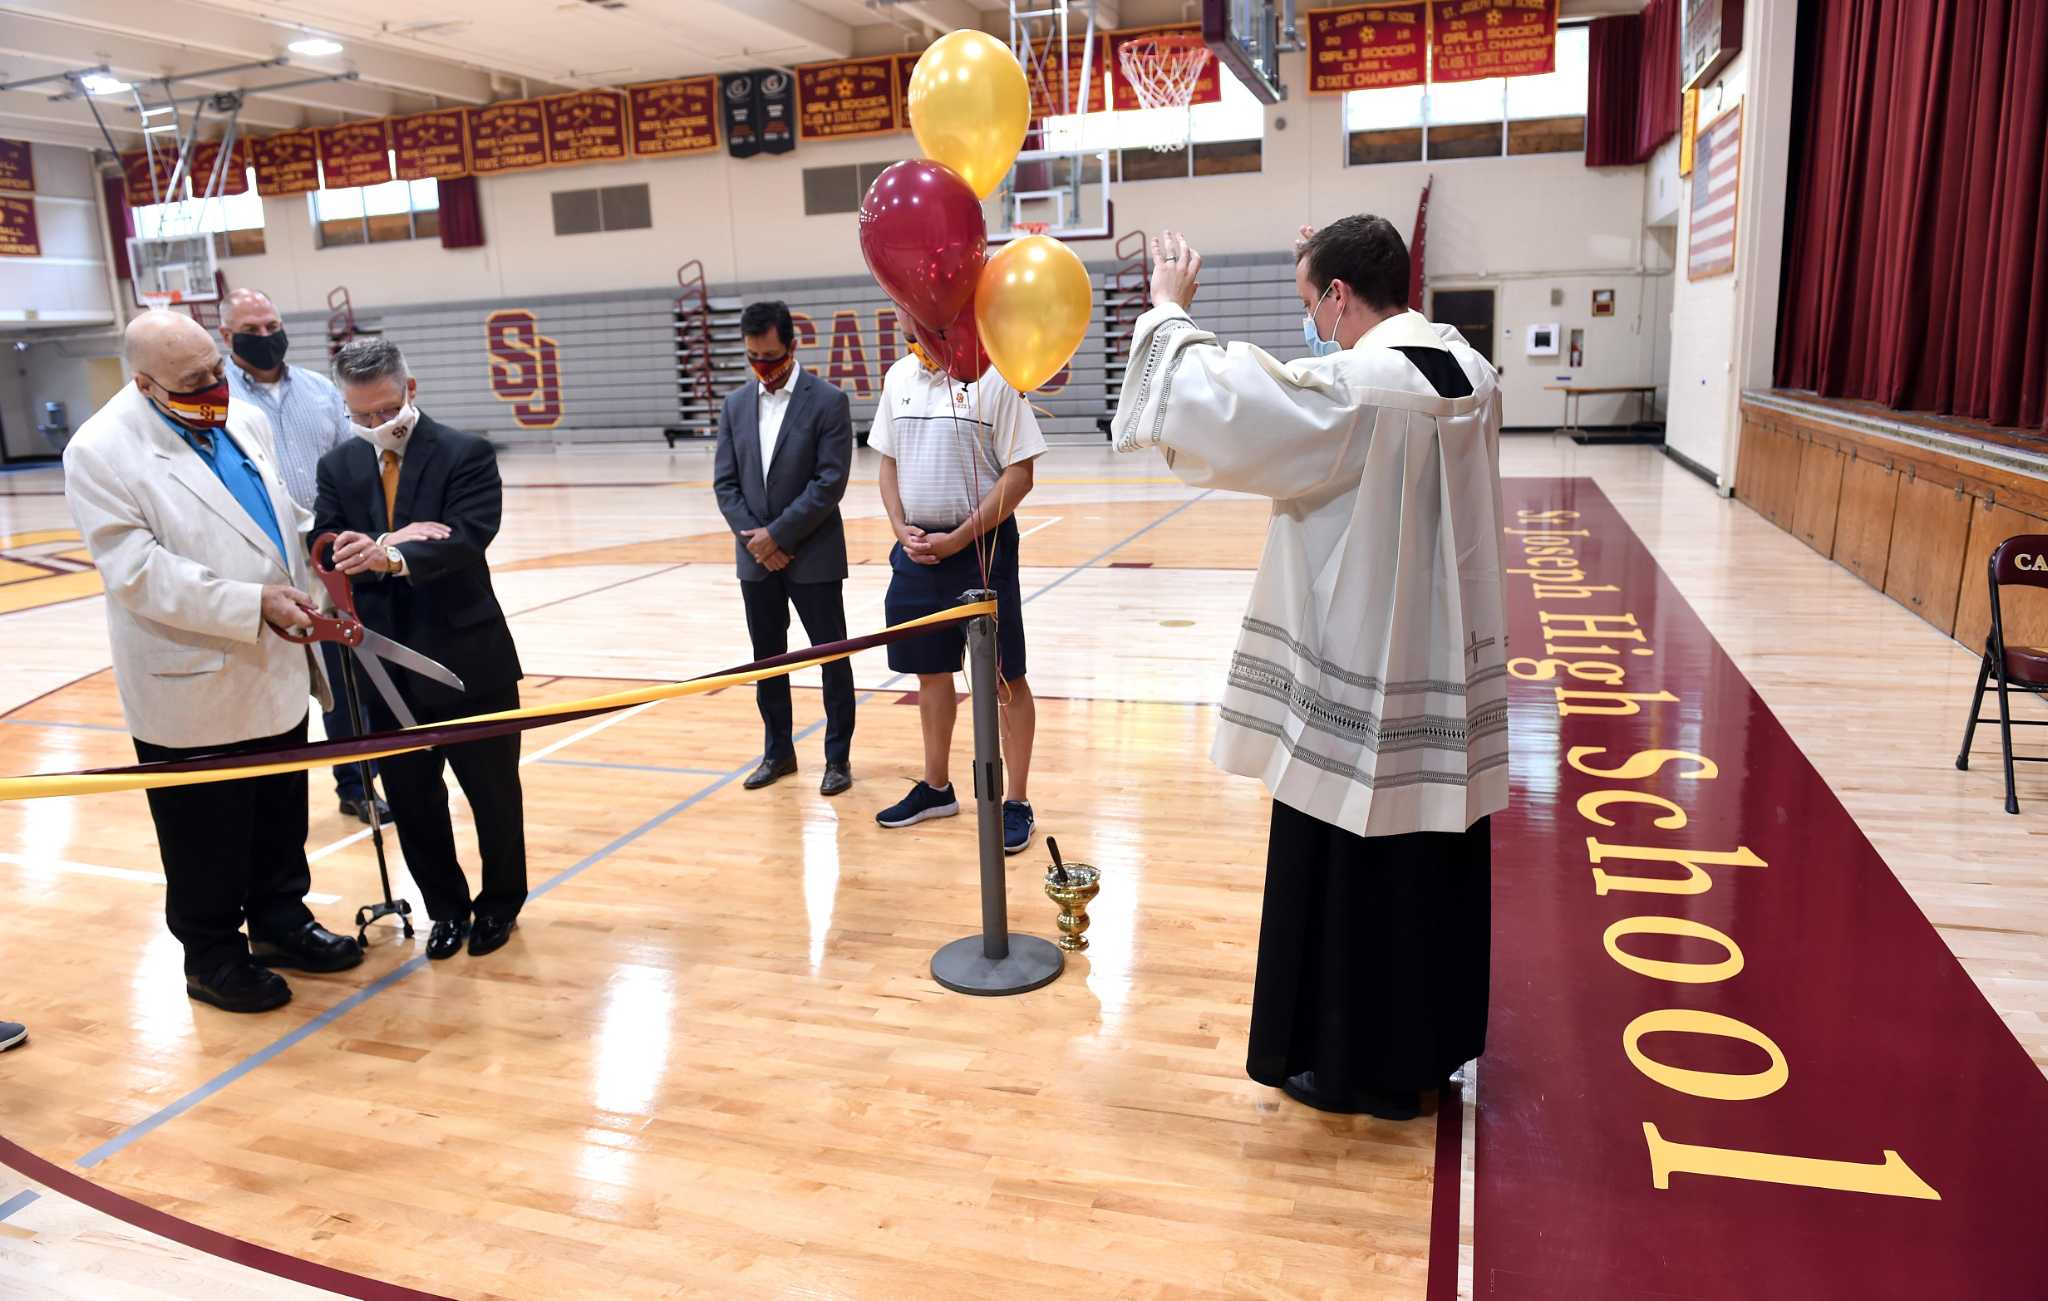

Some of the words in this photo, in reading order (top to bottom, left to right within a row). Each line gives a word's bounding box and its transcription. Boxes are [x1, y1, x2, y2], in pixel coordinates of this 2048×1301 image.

[1319, 48, 1357, 63] GIRLS
[1361, 43, 1416, 60] SOCCER
[1443, 30, 1483, 45] GIRLS
[1487, 24, 1544, 40] SOCCER
[1317, 74, 1350, 89] STATE
[1354, 67, 1418, 86] CHAMPIONS
[1503, 526, 1618, 599] Joseph
[1507, 610, 1680, 717] High
[1566, 745, 1943, 1201] School
